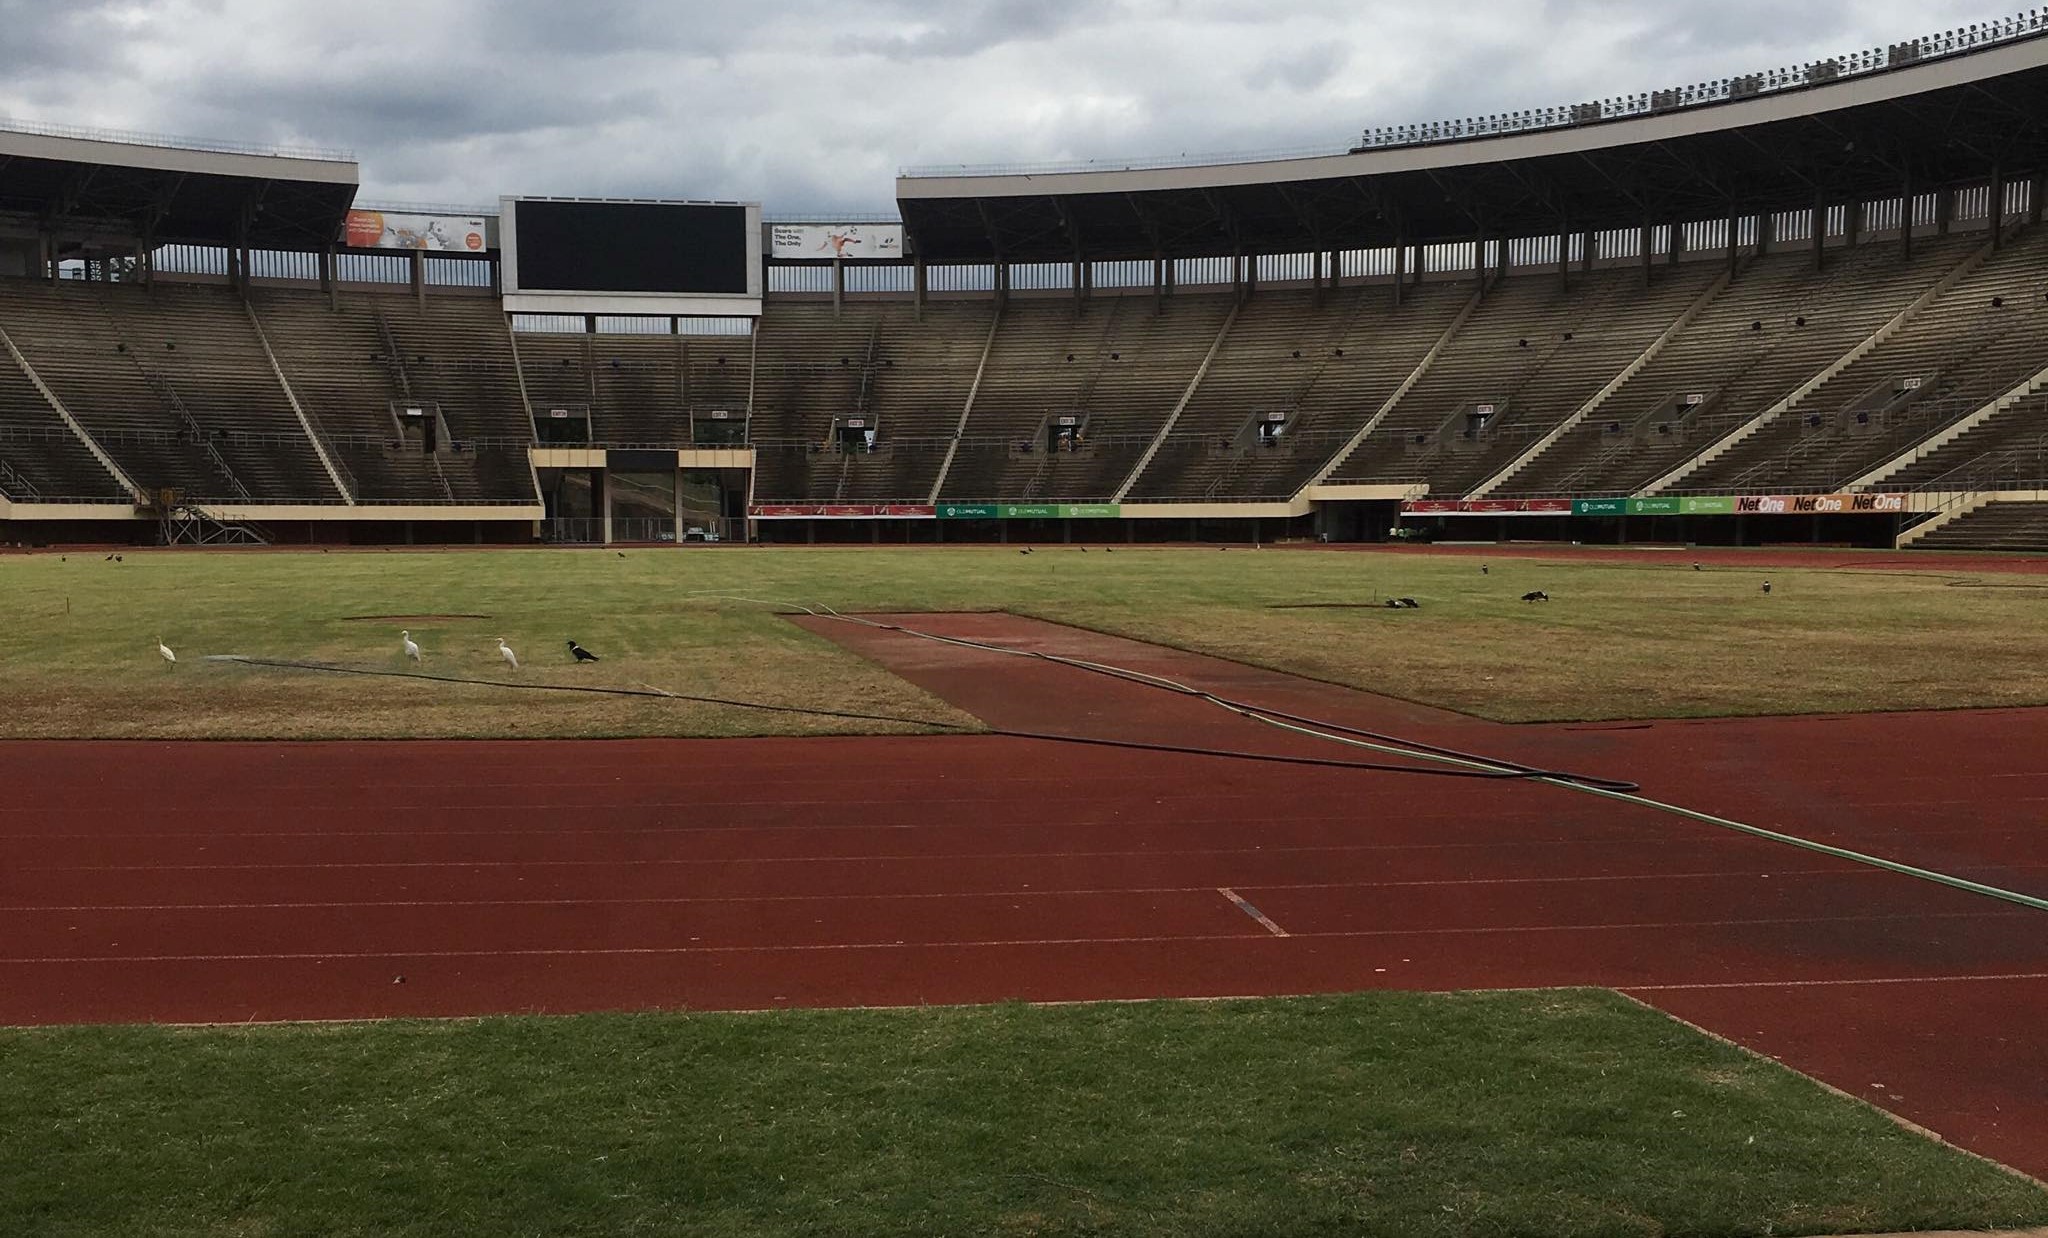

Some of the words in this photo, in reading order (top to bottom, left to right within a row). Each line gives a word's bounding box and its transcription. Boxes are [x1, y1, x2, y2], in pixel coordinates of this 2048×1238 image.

[1739, 497, 1785, 511] NetOne
[1794, 496, 1842, 511] NetOne
[1852, 494, 1902, 510] NetOne
